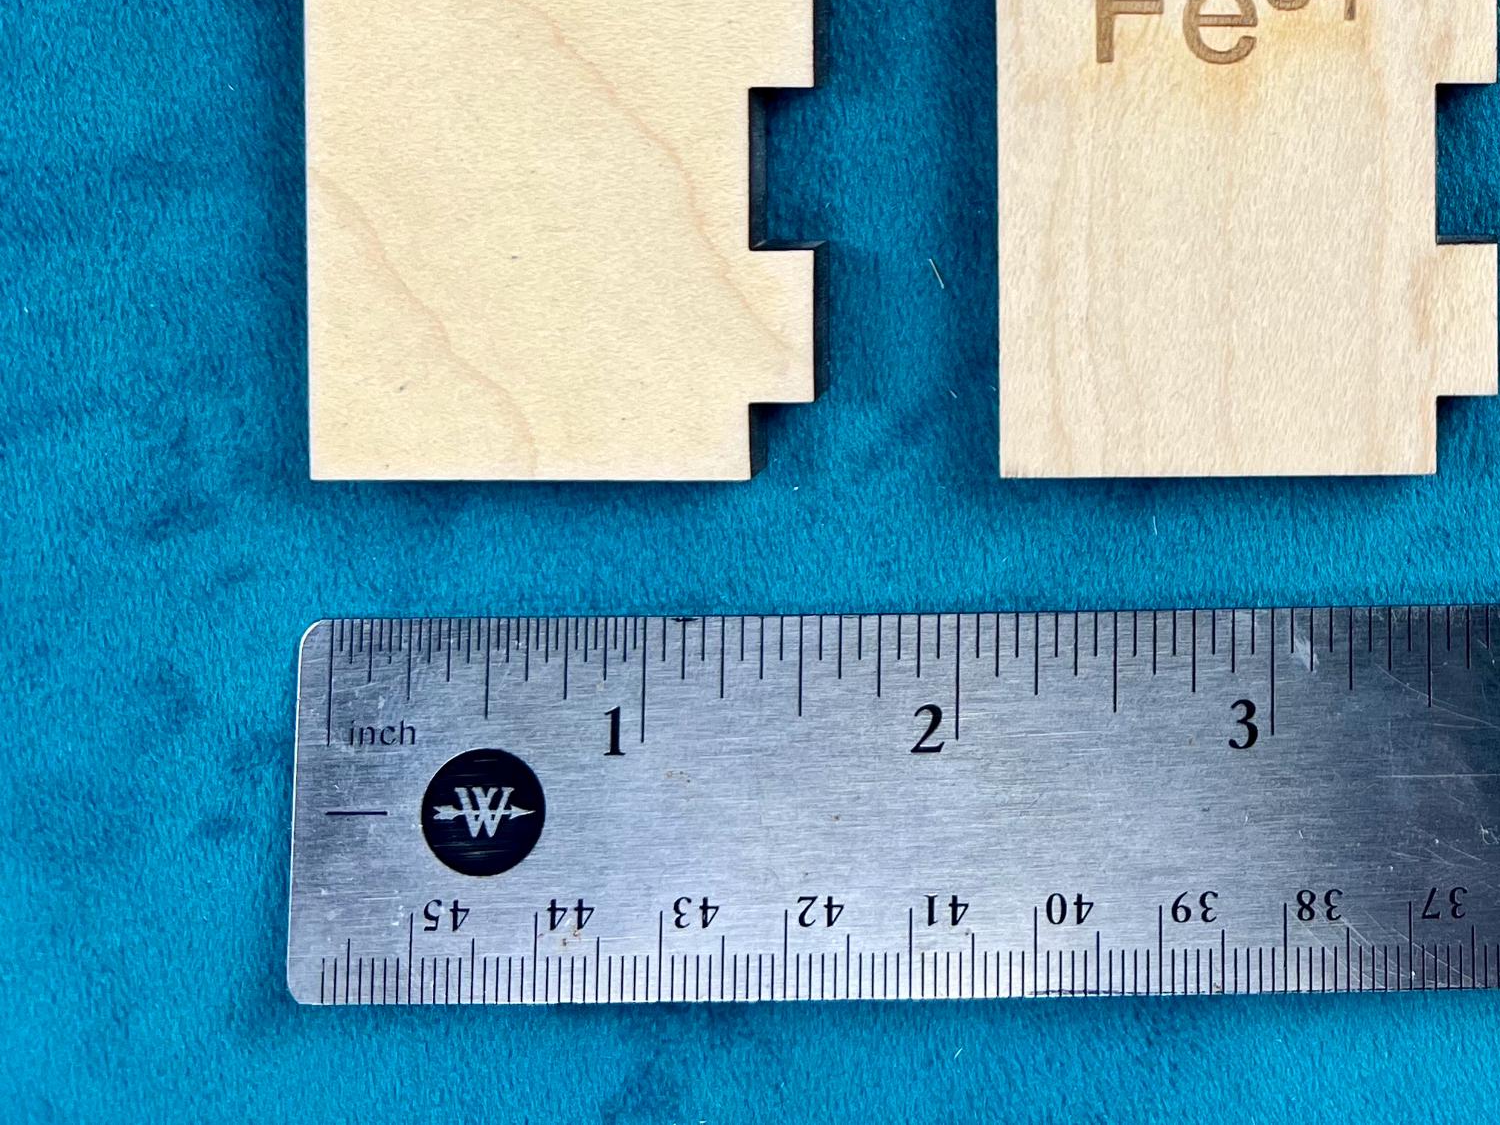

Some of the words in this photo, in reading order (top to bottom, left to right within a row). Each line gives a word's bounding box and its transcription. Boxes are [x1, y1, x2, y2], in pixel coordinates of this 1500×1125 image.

[348, 719, 417, 746] inch
[605, 707, 625, 756] 1
[910, 704, 945, 754] 2
[1227, 699, 1259, 750] 3
[423, 899, 470, 932] 45
[546, 898, 595, 930] 44
[672, 896, 720, 929] 43
[797, 895, 845, 928] 42
[925, 894, 970, 926] 41
[1045, 892, 1094, 925] 40
[1171, 890, 1219, 924] 39
[1296, 888, 1343, 922] 38
[1421, 886, 1468, 920] 37
